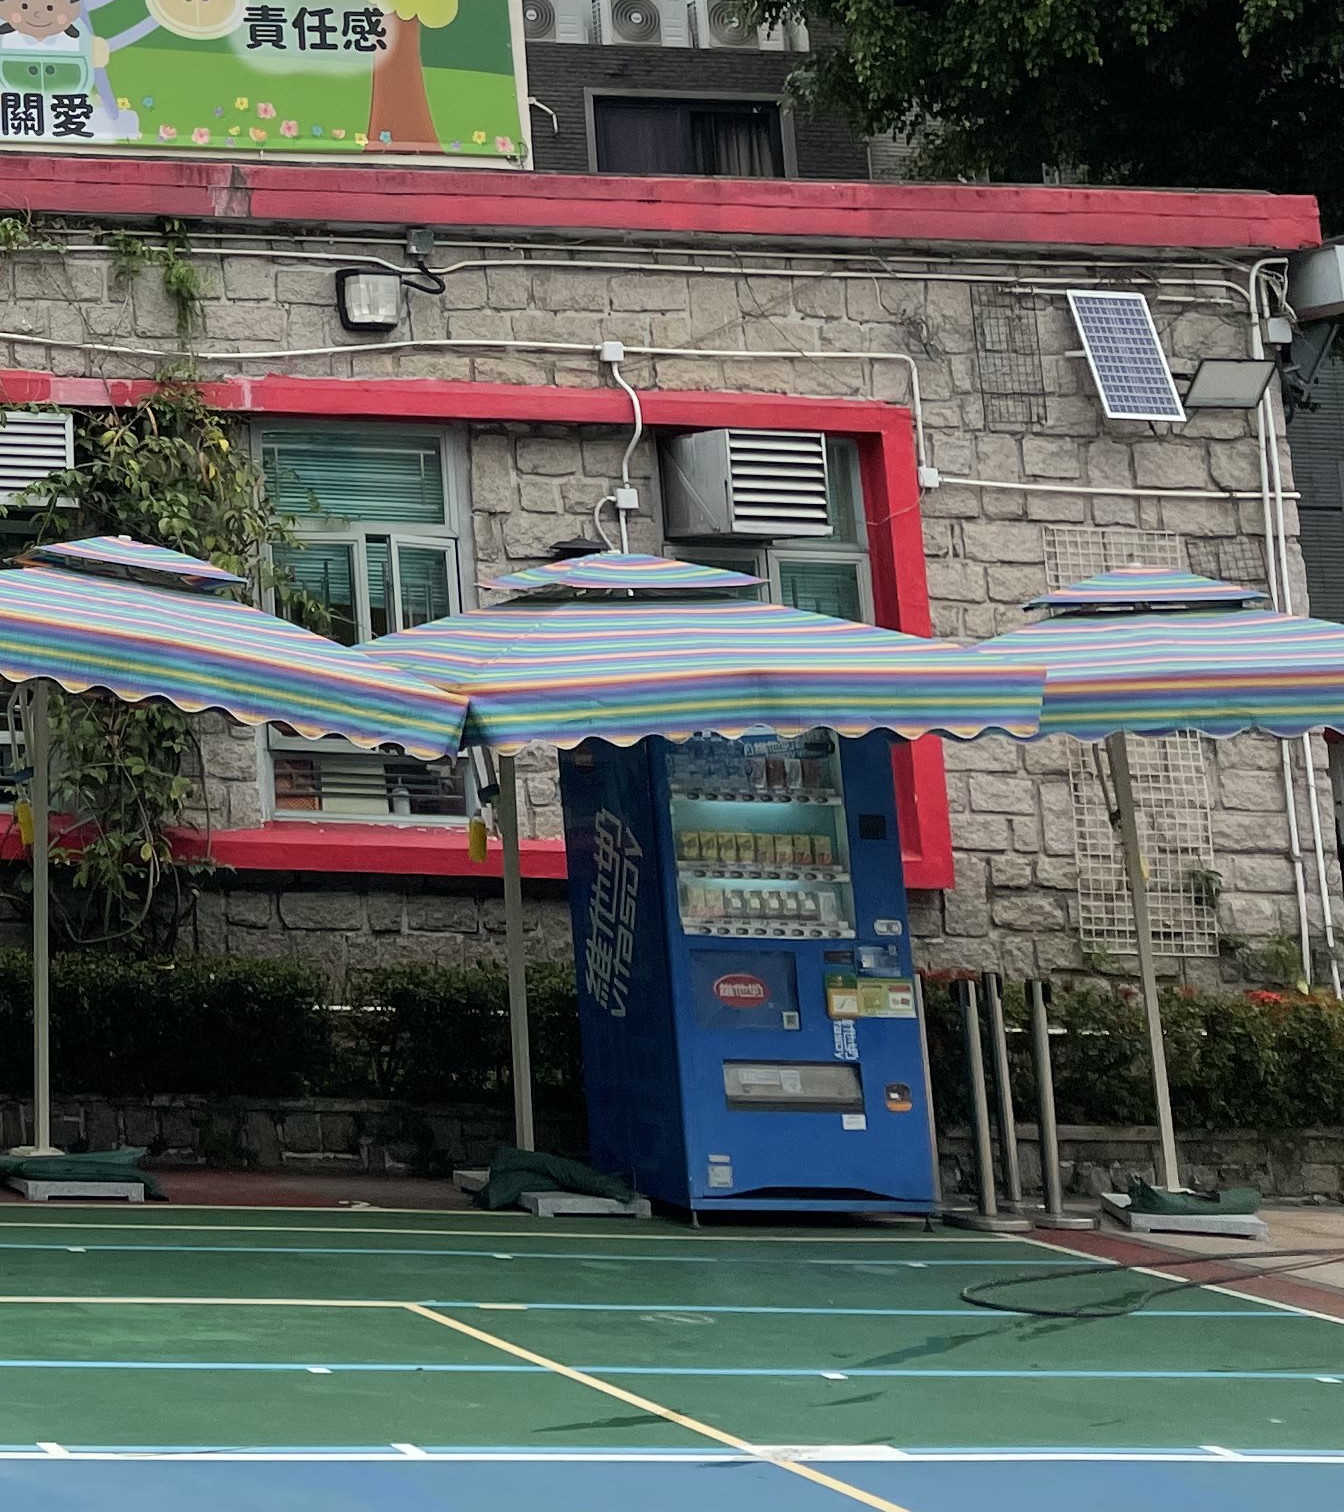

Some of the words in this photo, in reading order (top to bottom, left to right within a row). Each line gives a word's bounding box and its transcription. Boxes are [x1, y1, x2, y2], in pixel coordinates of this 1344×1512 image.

[243, 5, 388, 52] 責任感
[0, 93, 95, 138] 關愛
